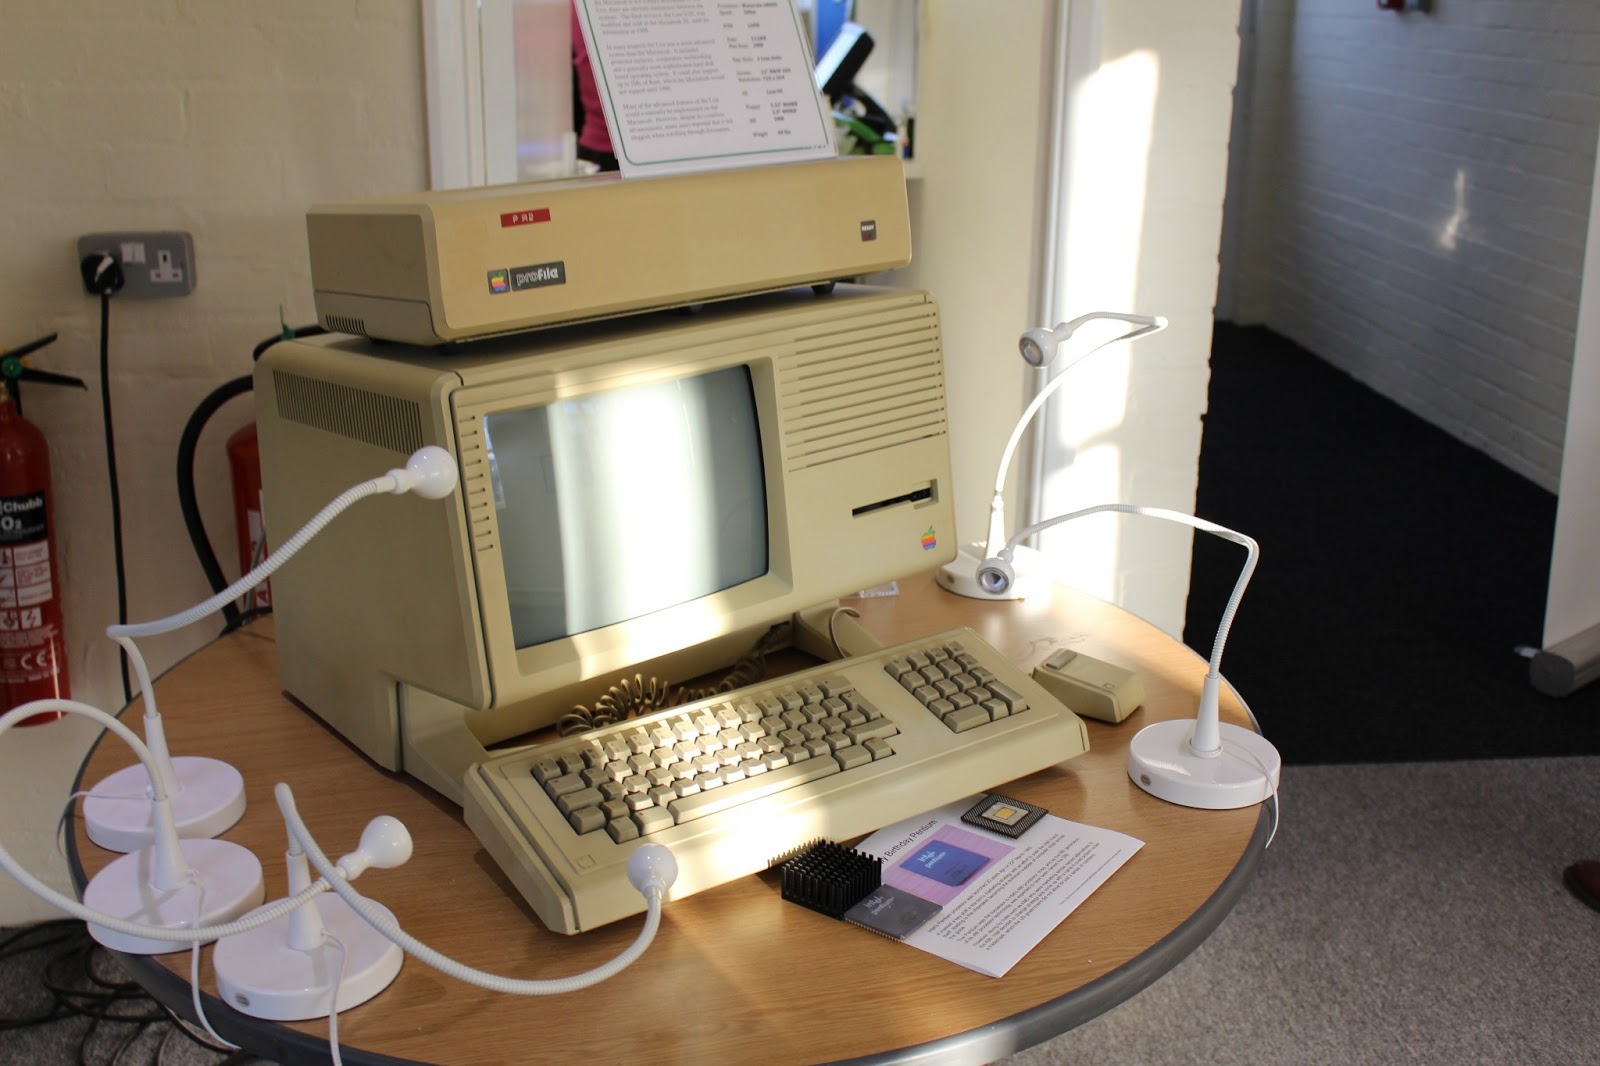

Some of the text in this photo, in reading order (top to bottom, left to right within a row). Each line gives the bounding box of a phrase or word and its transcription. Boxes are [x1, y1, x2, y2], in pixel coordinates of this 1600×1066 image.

[3, 497, 43, 513] Chubb
[884, 820, 938, 858] Birthday Pentium
